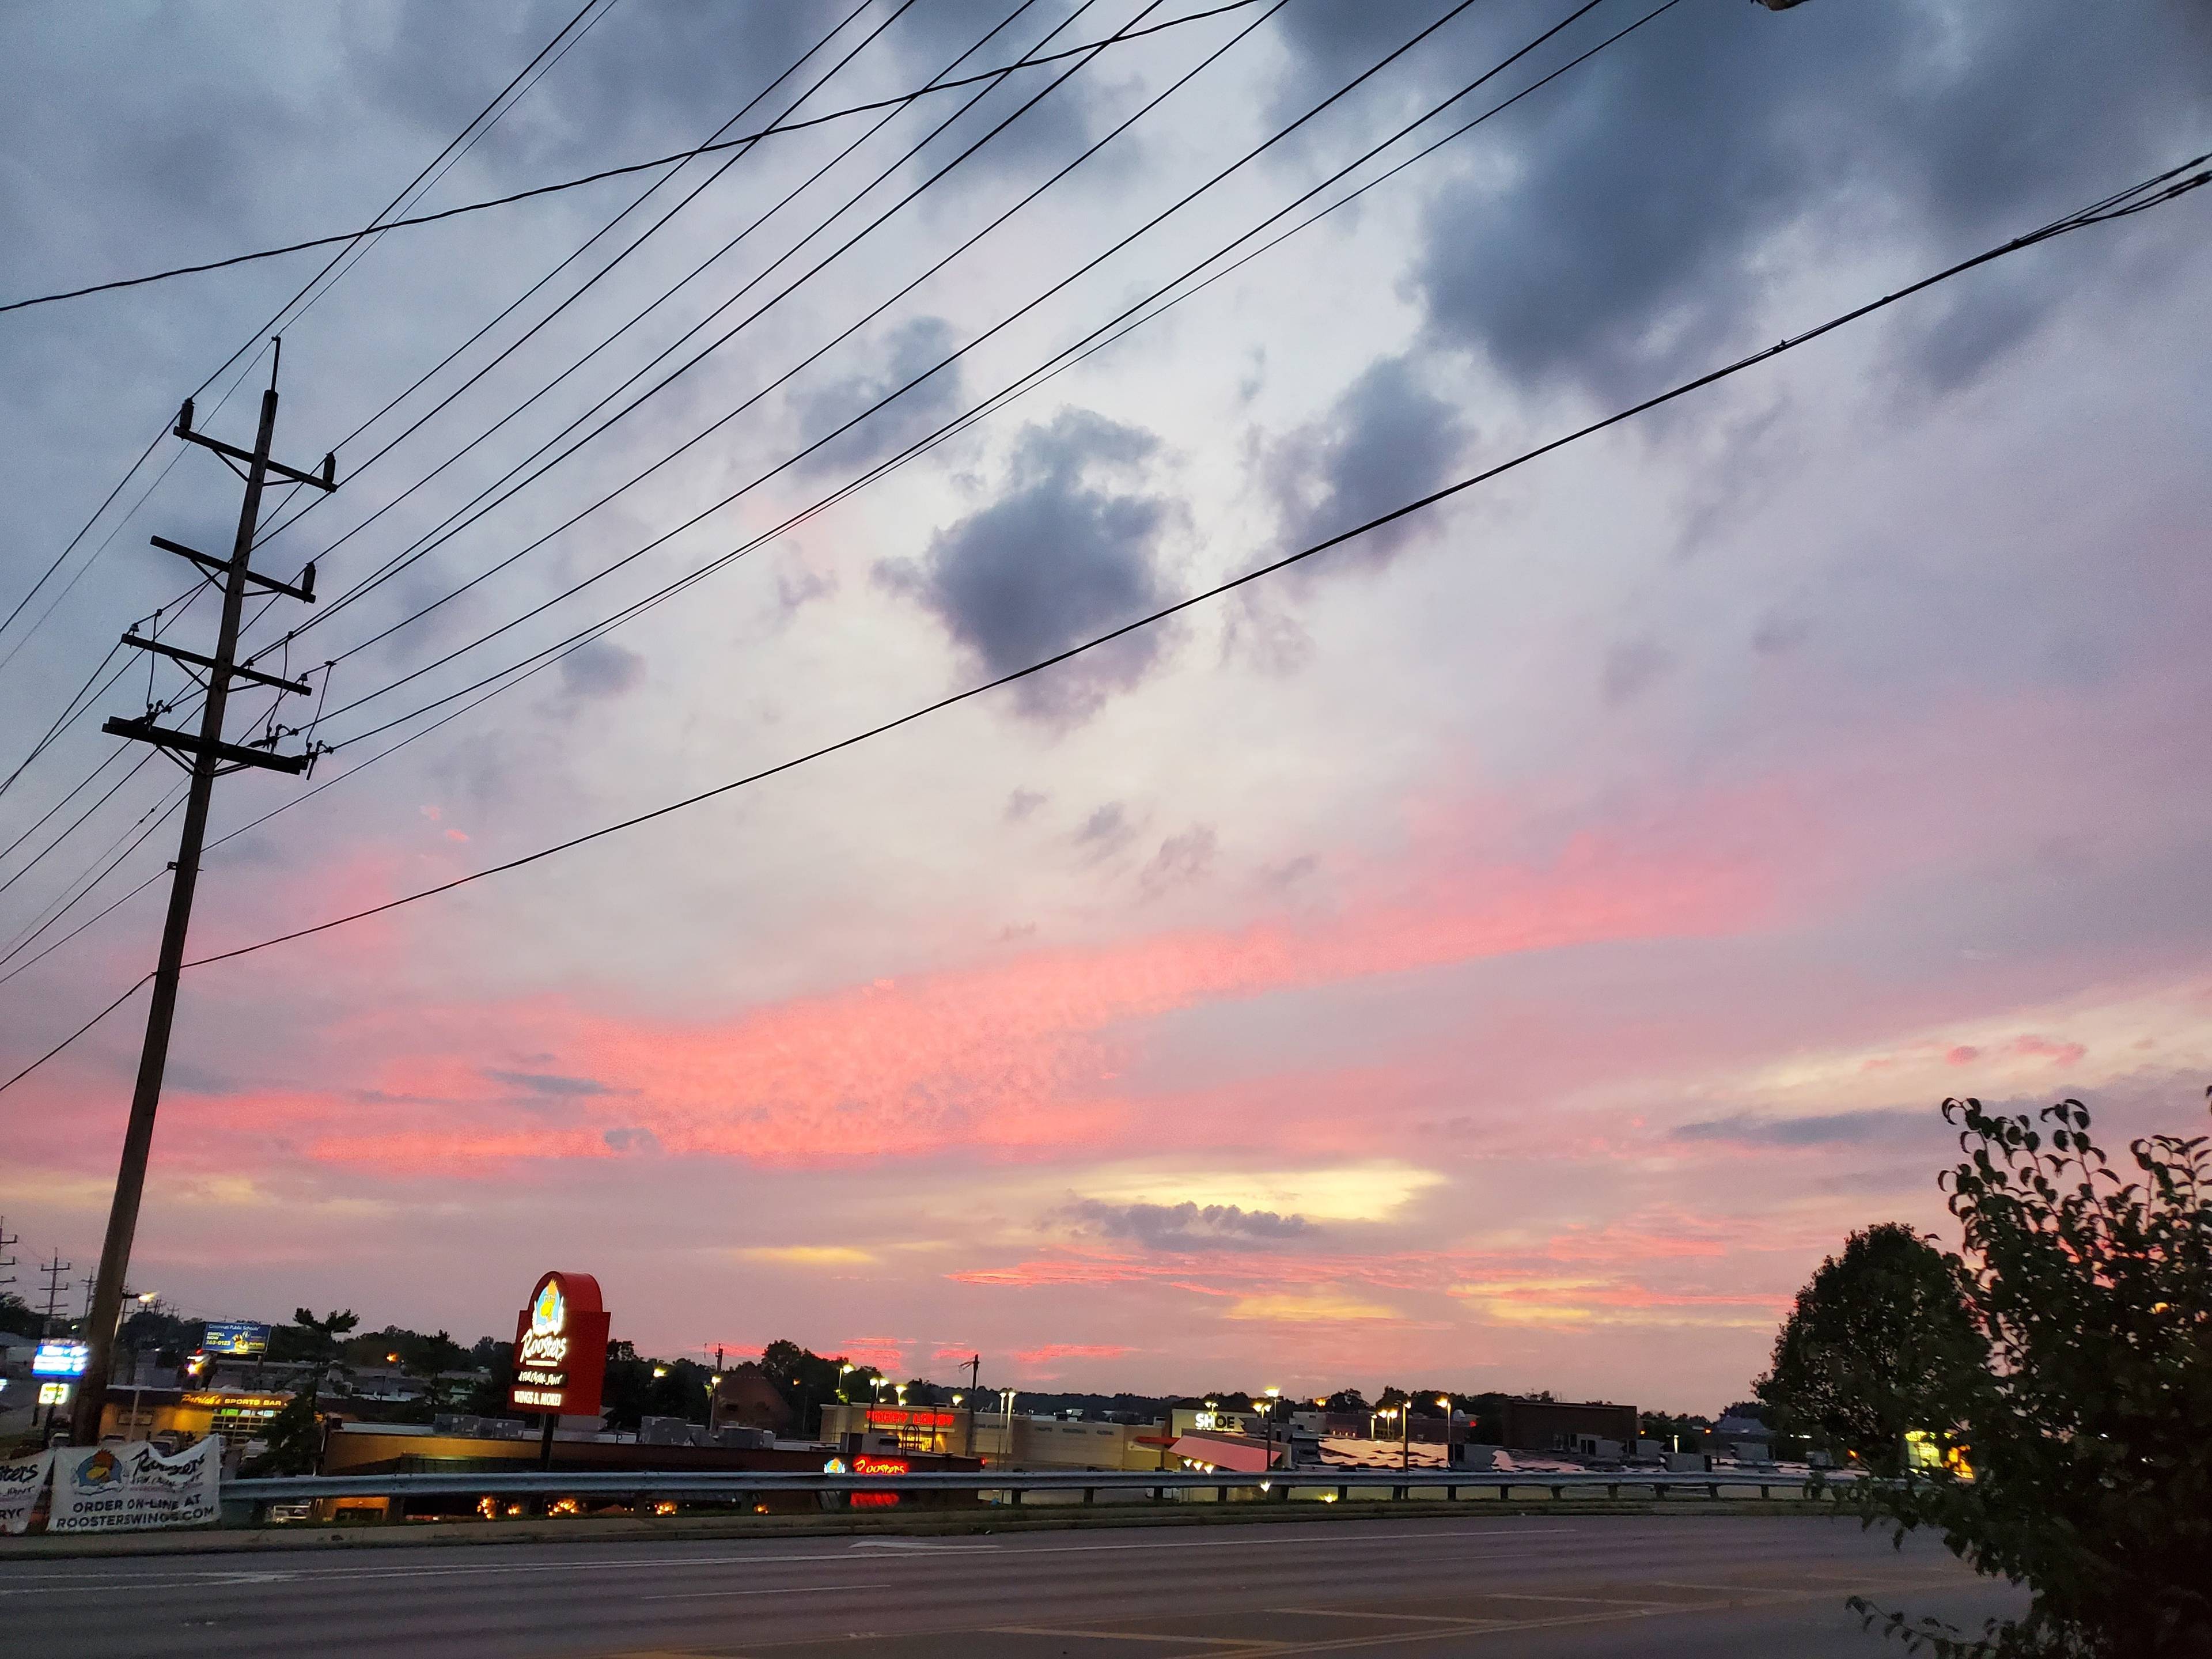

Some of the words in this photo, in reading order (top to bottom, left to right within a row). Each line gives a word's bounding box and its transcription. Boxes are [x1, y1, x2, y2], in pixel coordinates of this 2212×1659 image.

[520, 1328, 567, 1363] Roosters
[514, 1391, 534, 1404] WINGS
[533, 1392, 540, 1404] &
[1195, 1413, 1235, 1429] SHOE
[73, 1499, 123, 1513] ORDER
[127, 1498, 179, 1510] ON-LINE
[184, 1494, 202, 1507] AT
